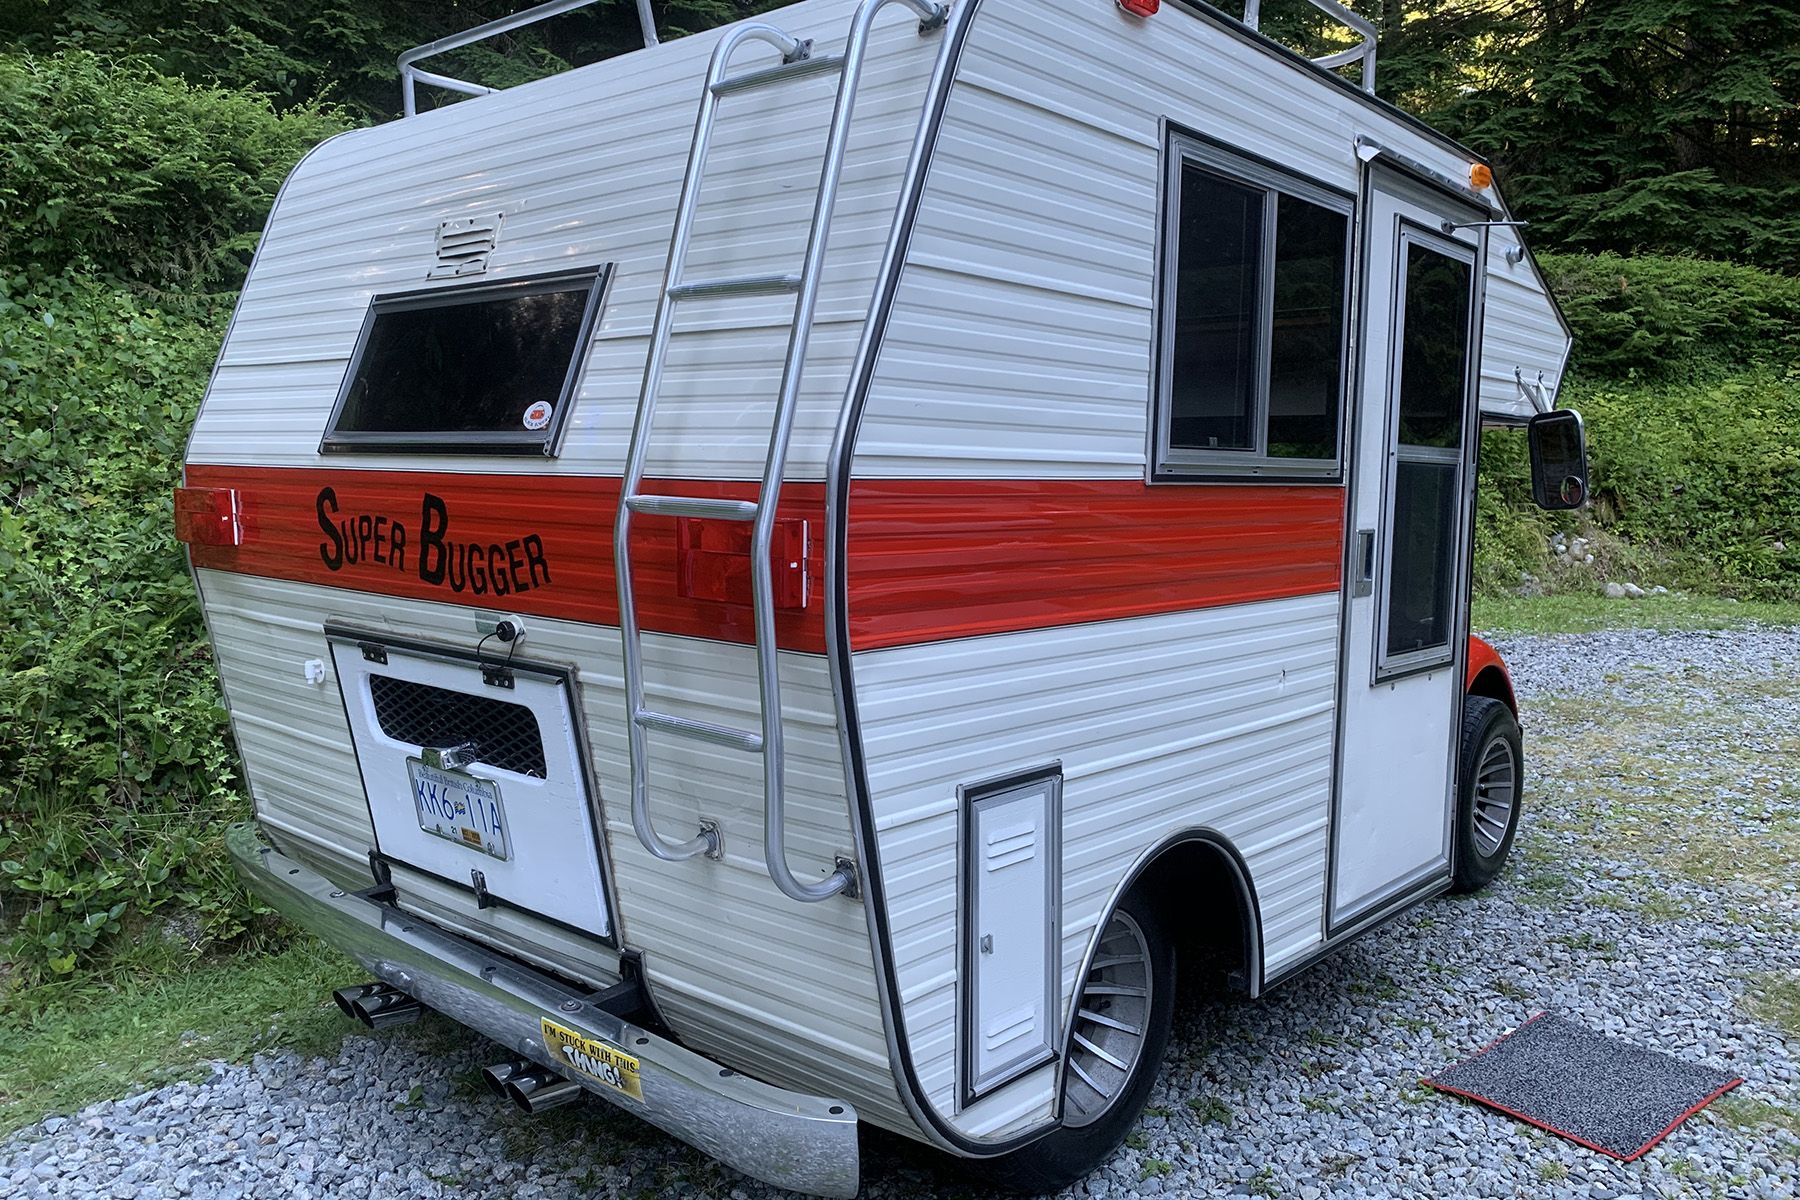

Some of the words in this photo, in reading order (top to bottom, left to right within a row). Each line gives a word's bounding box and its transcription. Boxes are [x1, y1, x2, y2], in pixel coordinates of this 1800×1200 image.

[316, 486, 406, 572] SUPER
[419, 492, 552, 596] BUGGER
[416, 779, 455, 820] KK6
[544, 1023, 557, 1038] I'M
[559, 1031, 586, 1052] STUCK
[562, 1045, 623, 1089] THING!
